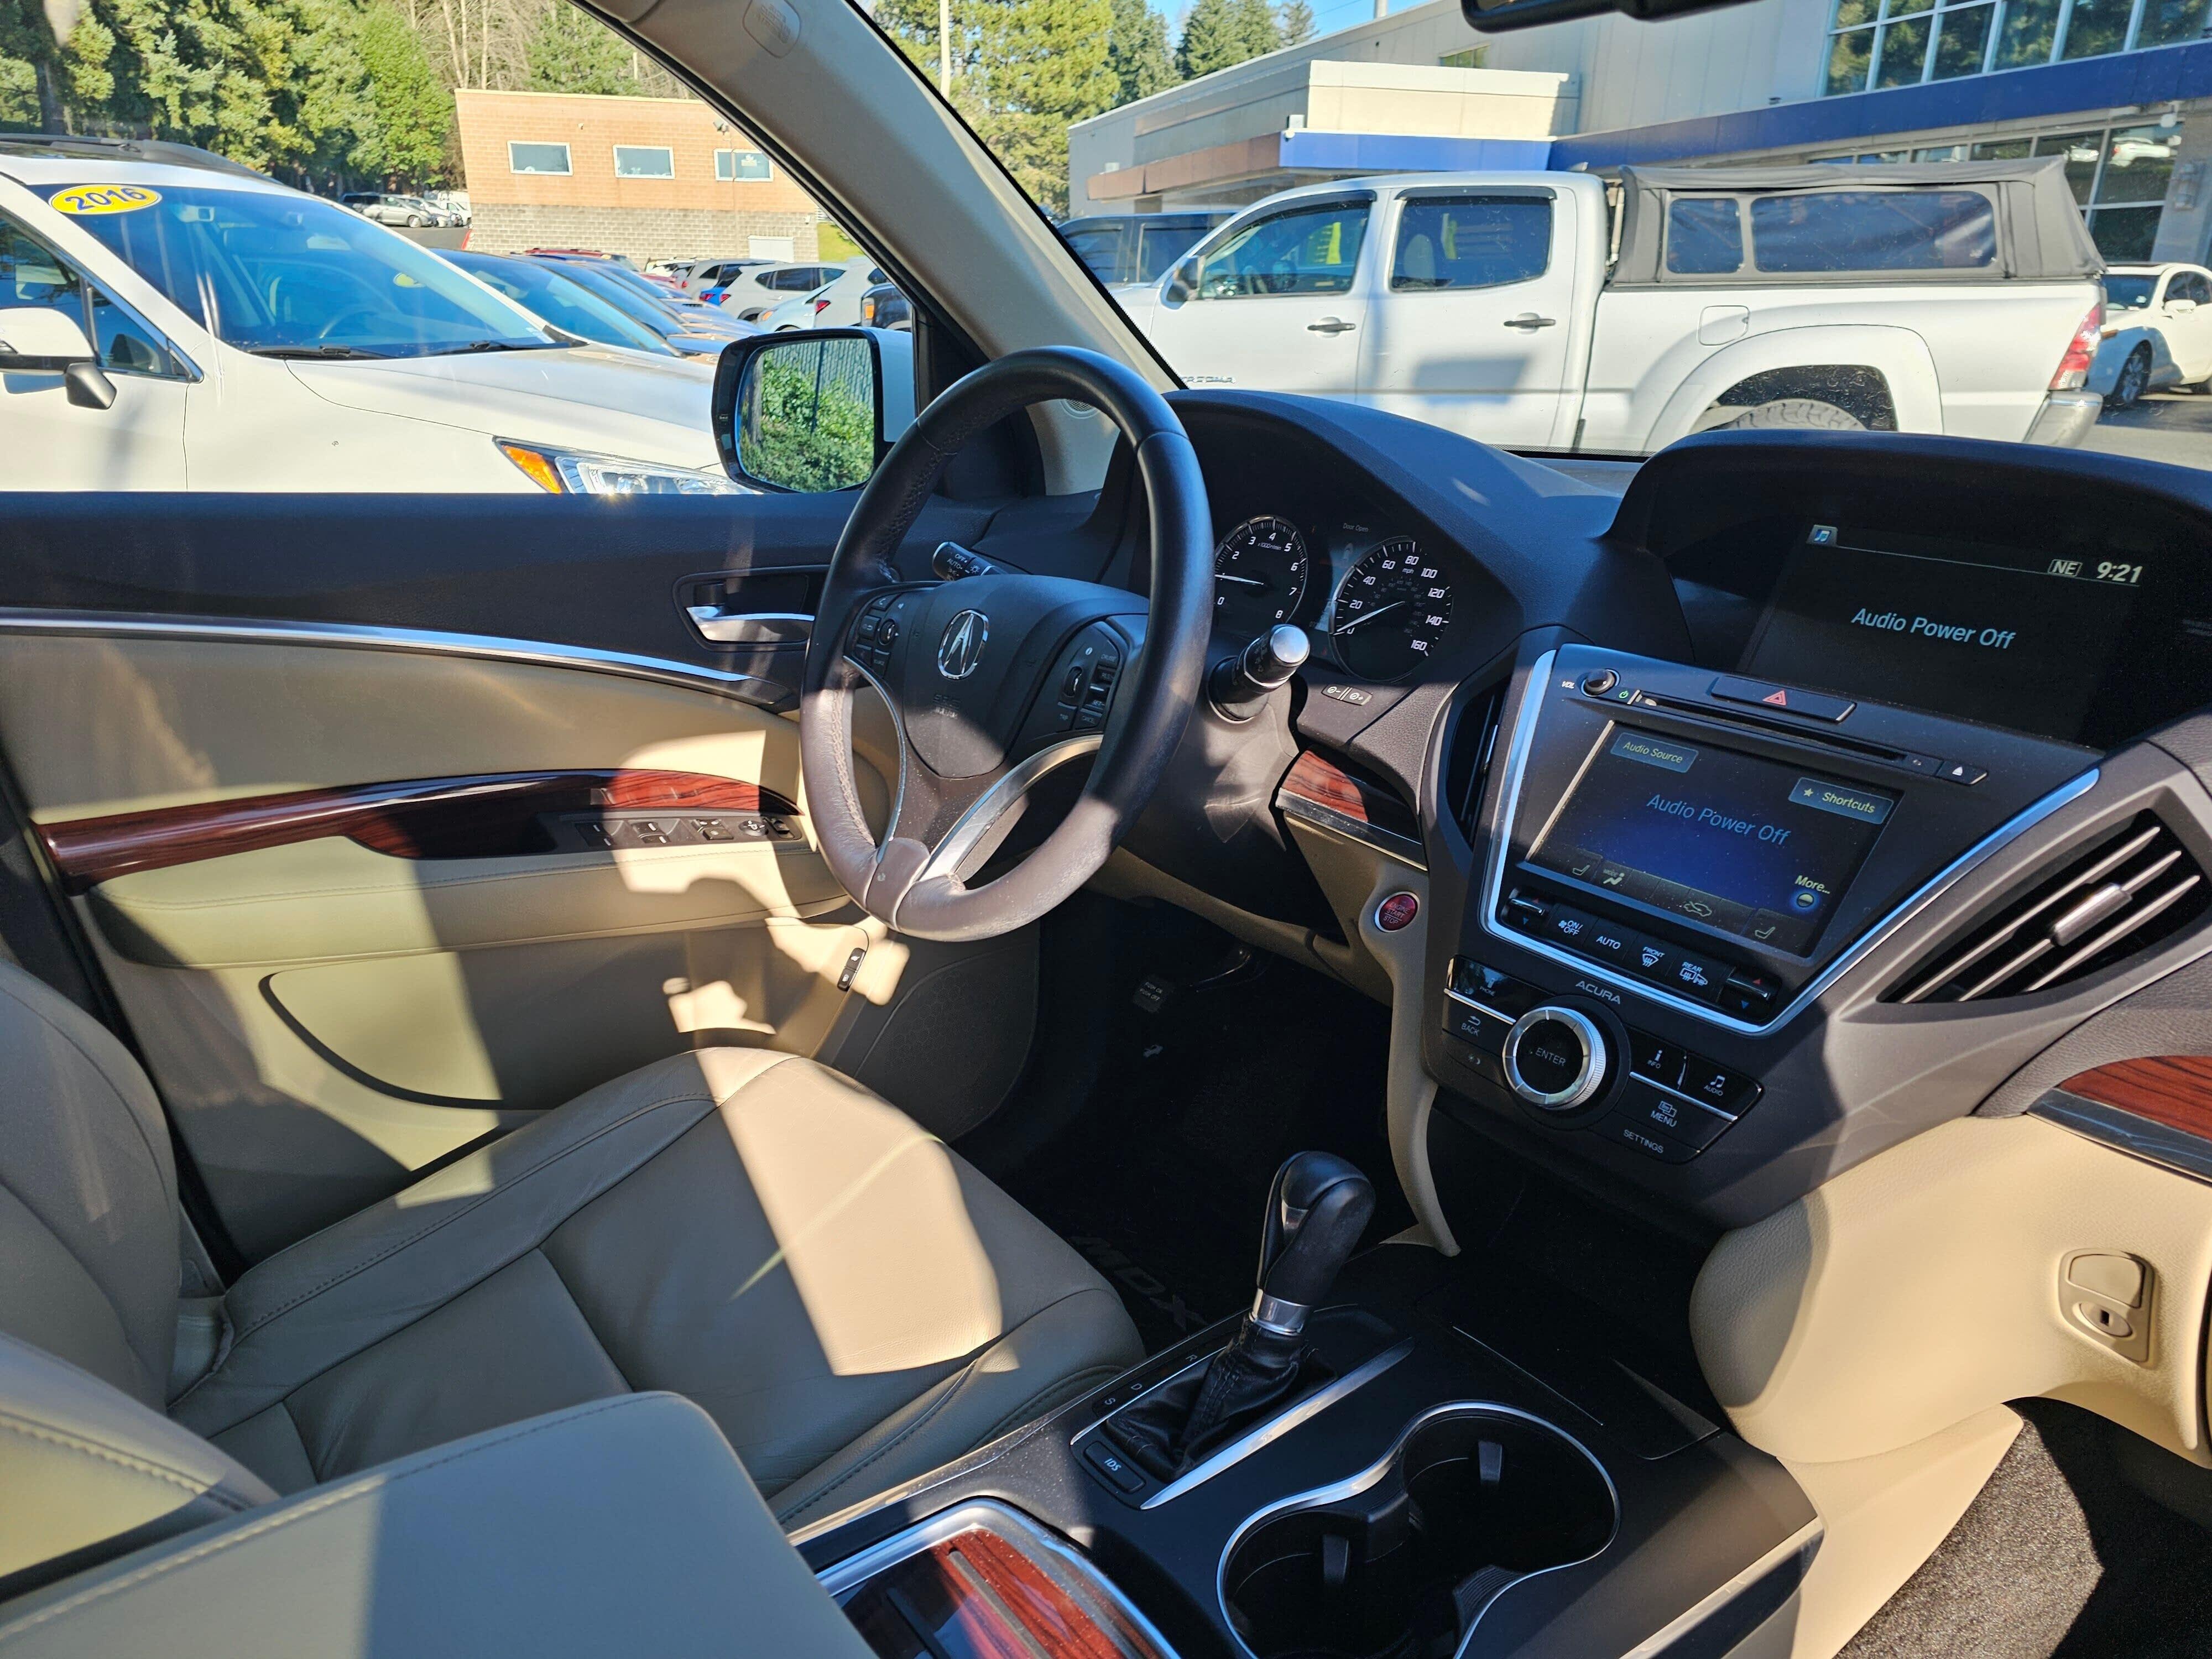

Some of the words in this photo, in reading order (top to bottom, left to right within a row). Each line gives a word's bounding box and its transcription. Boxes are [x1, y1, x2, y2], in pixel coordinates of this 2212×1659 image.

[64, 187, 147, 211] 2016
[1355, 524, 1369, 533] Open
[1248, 536, 1256, 545] 3
[1269, 532, 1276, 541] 4
[1284, 542, 1292, 552] 5
[1232, 551, 1240, 560] 2
[1405, 555, 1420, 565] 80
[1290, 562, 1299, 571] 6
[1382, 560, 1396, 570] 60
[2052, 561, 2078, 576] NE
[1421, 567, 1438, 578] 100
[2096, 561, 2143, 583] 9:21
[1363, 576, 1376, 585] 40
[1288, 587, 1297, 596] 7
[1427, 587, 1446, 598] 120
[1217, 597, 1225, 606] 0
[1349, 599, 1363, 609] 20
[1275, 609, 1284, 619] 8
[1425, 614, 1443, 626] 140
[1851, 608, 1907, 631] Audio
[1910, 617, 1976, 643] Power
[1979, 628, 2017, 650] Off
[1410, 639, 1427, 651] 160
[1561, 681, 1575, 689] VOL
[1623, 740, 1650, 755] Audio
[1650, 748, 1683, 764] Source
[1822, 791, 1876, 813] Shortcuts
[1646, 794, 1695, 818] Audio
[1697, 807, 1756, 836] Power
[1757, 825, 1792, 846] Off
[1386, 907, 1406, 919] START
[1390, 902, 1411, 914] ENGINE
[1383, 915, 1399, 925] STOP
[1567, 920, 1584, 931] ON/
[1563, 926, 1580, 936] OFF
[1595, 935, 1621, 950] AUTO
[1642, 946, 1666, 958] FRONT
[1681, 962, 1703, 973] REAR
[1575, 980, 1621, 1005] ACURA
[1460, 1022, 1480, 1037] BACK
[1535, 1047, 1567, 1067] ENTER
[1647, 1060, 1661, 1070] INFO
[1703, 1084, 1724, 1097] AUDIO
[1650, 1110, 1678, 1128] MENU
[1623, 1129, 1664, 1154] SETTINGS
[1130, 1383, 1143, 1391] D
[1104, 1397, 1117, 1405] S
[1103, 1457, 1122, 1472] IDS
